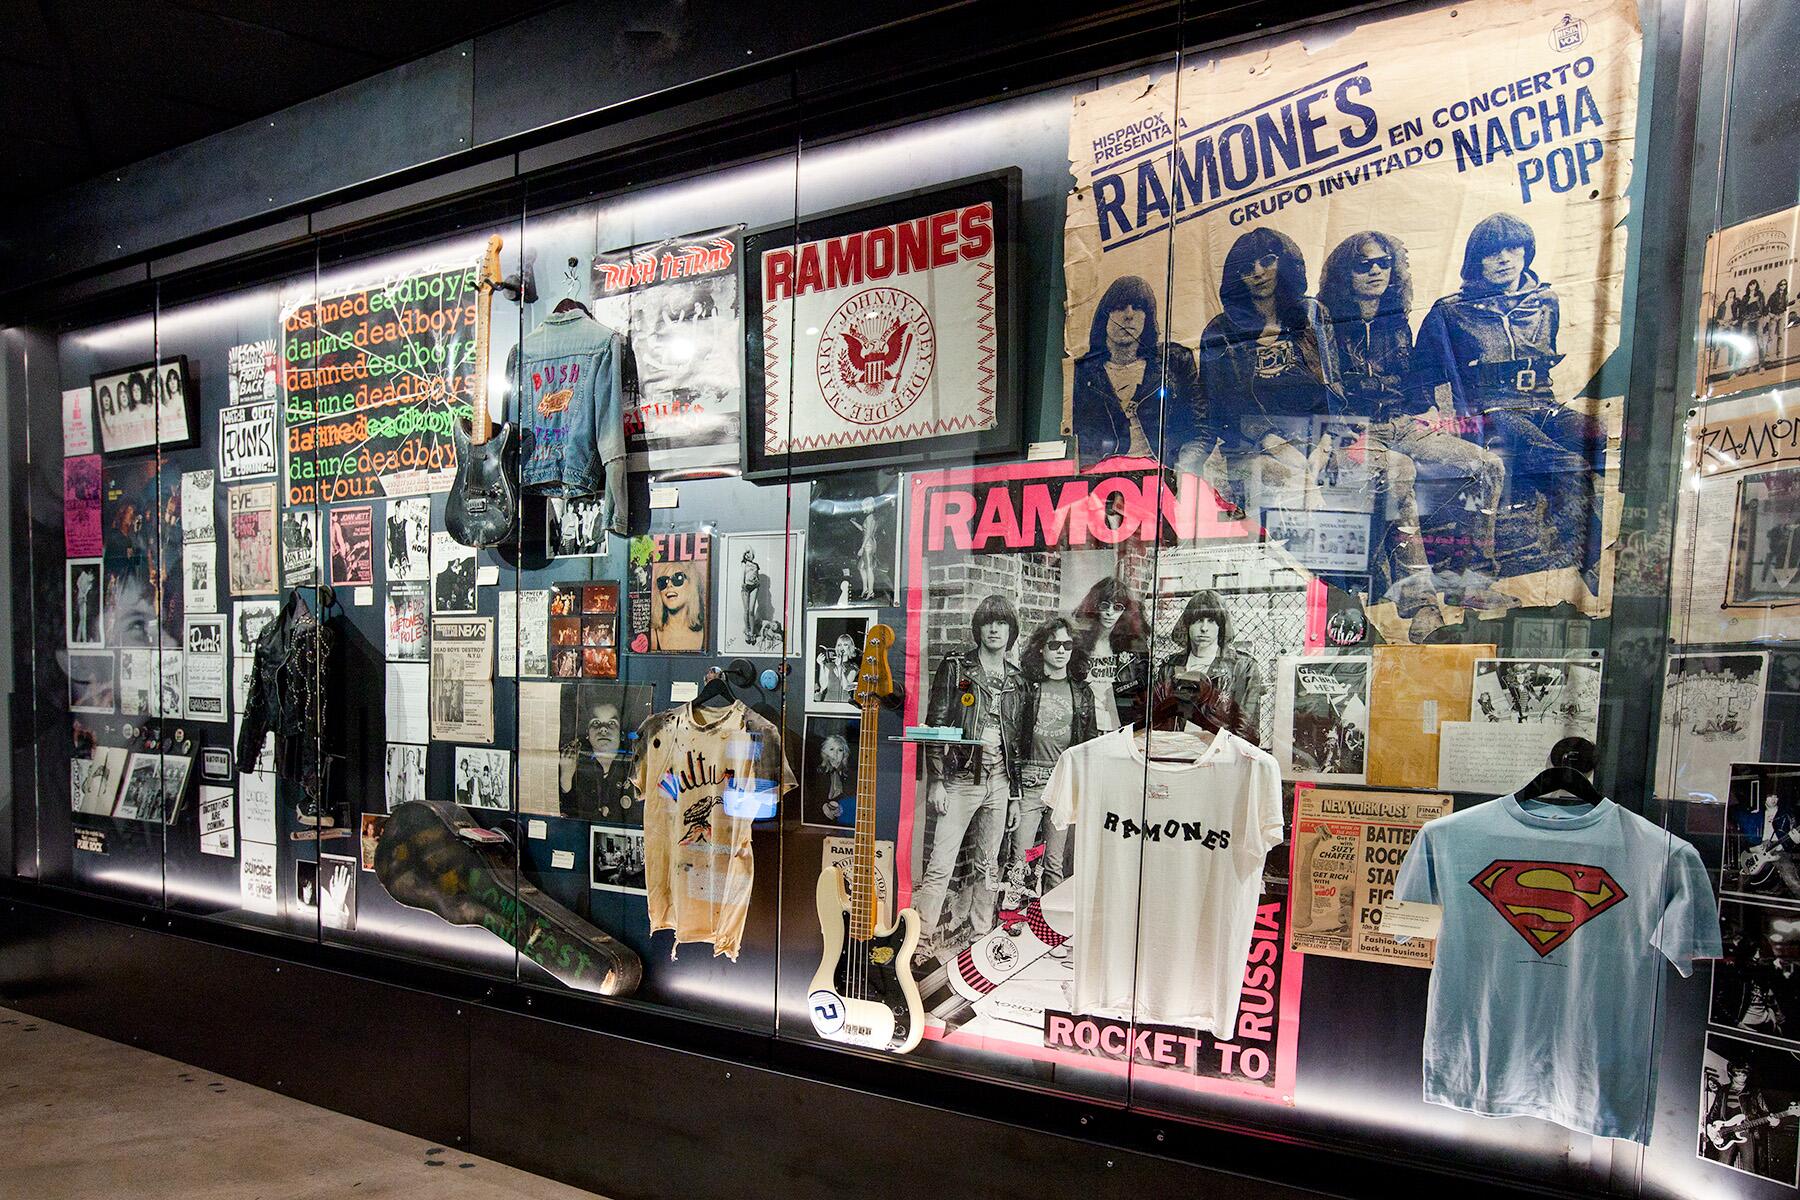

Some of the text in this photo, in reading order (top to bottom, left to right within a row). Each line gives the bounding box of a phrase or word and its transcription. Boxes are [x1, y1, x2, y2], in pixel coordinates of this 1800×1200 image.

[1388, 55, 1595, 145] EN CONCIERTO
[1092, 111, 1165, 151] HISPAVOX
[1094, 124, 1172, 164] PRESENTA
[1092, 76, 1382, 241] RAMONES
[1229, 85, 1605, 227] GRUPO INVITADO NACHA
[1518, 137, 1605, 204] POP
[661, 238, 736, 281] TETRAS
[766, 202, 993, 302] RAMONES
[839, 291, 914, 326] JOHNNY
[911, 313, 933, 365] JOEY
[820, 331, 845, 409] MARKY
[240, 380, 263, 396] BACK
[225, 422, 272, 462] PUNK
[223, 466, 233, 478] IS
[289, 484, 315, 504] on
[320, 477, 377, 500] tour
[652, 532, 710, 562] FILE
[190, 625, 220, 652] Punk
[458, 624, 486, 637] NEWS
[211, 810, 222, 821] ARE
[1322, 799, 1349, 813] NEW
[1348, 801, 1380, 817] YORK
[1379, 804, 1410, 819] POST
[206, 819, 226, 832] COMING
[1103, 811, 1231, 851] RAMONES
[831, 846, 883, 858] RAMS
[1319, 851, 1356, 860] CHAFFEE
[1331, 845, 1354, 853] SUZY
[1365, 847, 1409, 865] ROCK
[1312, 871, 1328, 879] GET
[1367, 867, 1400, 885] STA
[1361, 907, 1383, 925] FO
[1360, 944, 1380, 953] back
[1393, 948, 1429, 958] business
[1364, 935, 1398, 946] Fashion
[1418, 940, 1425, 948] is
[1238, 901, 1283, 1042] RUSSIA
[1049, 1014, 1270, 1080] ROCKET TO
